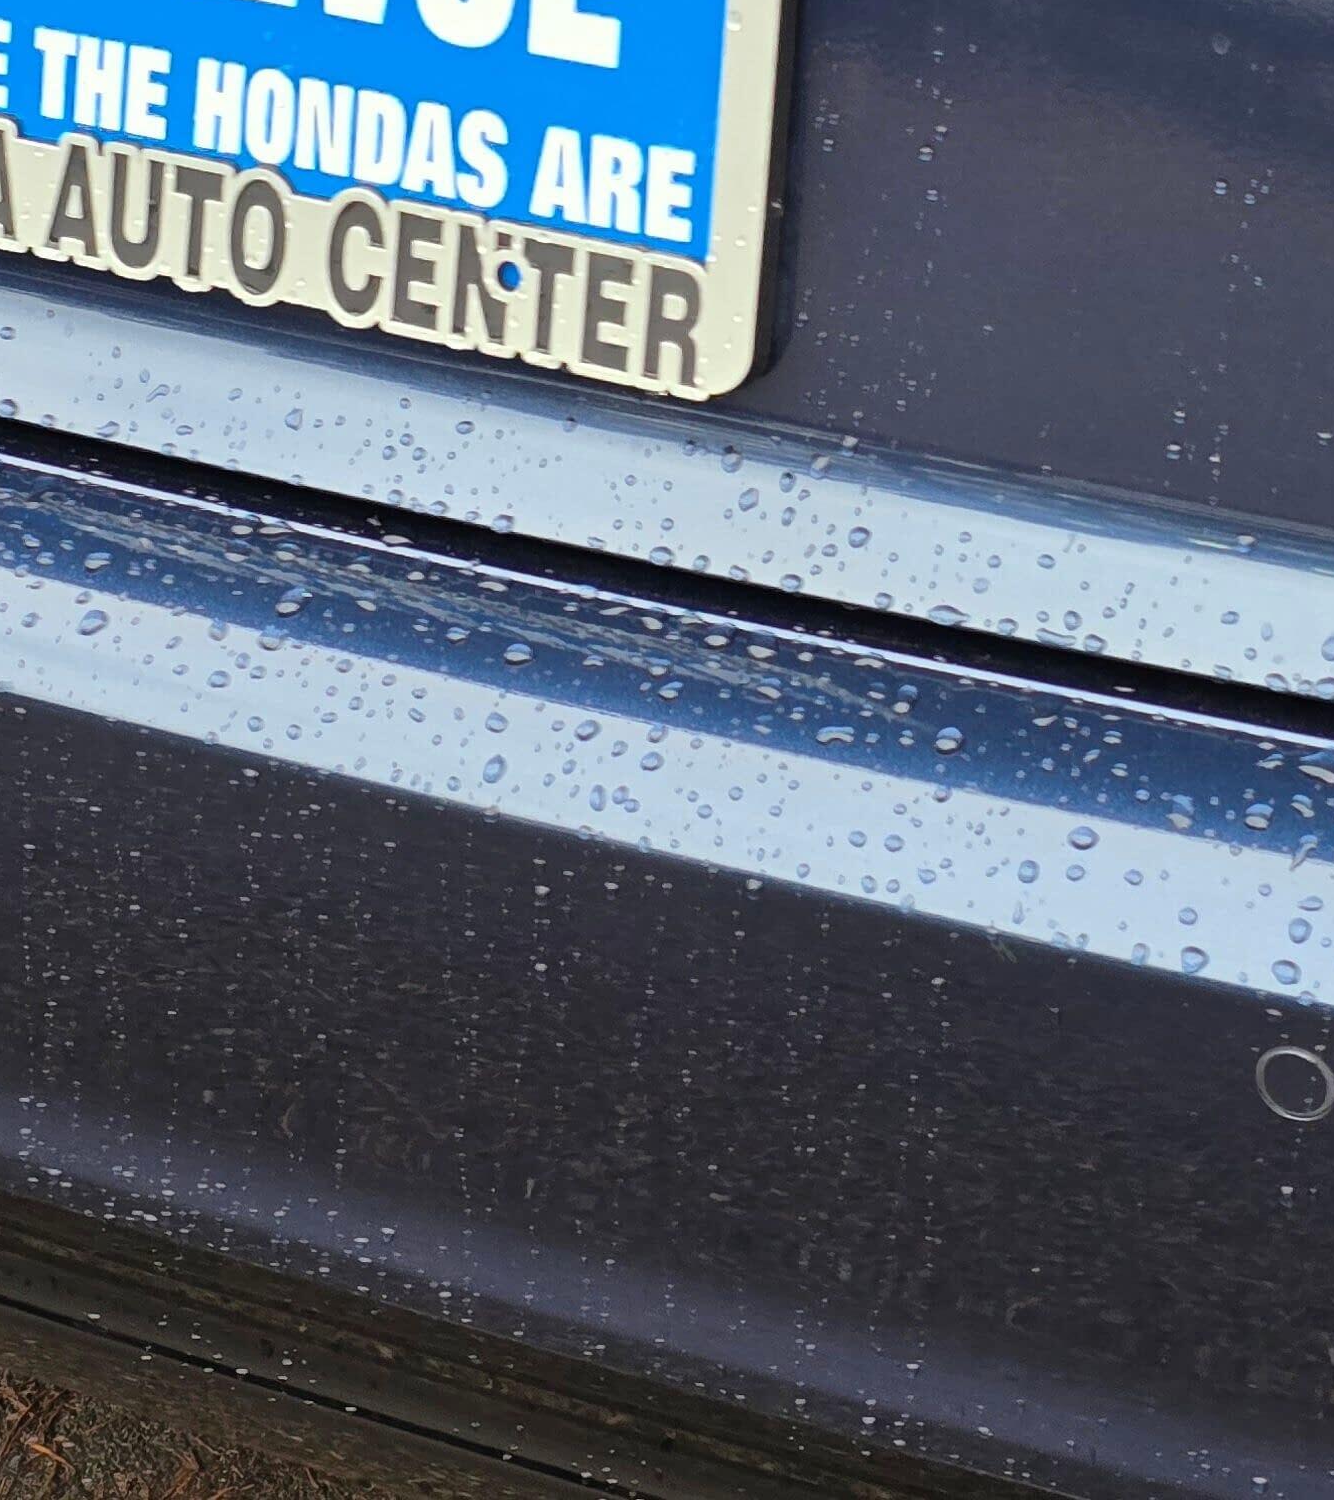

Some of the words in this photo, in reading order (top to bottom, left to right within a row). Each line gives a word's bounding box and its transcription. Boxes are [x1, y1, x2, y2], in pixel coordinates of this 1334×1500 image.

[33, 25, 172, 141] THE
[192, 56, 509, 208] HONDAS
[528, 125, 698, 243] ARE
[45, 143, 286, 295] AUTO
[329, 199, 703, 387] CENTER
